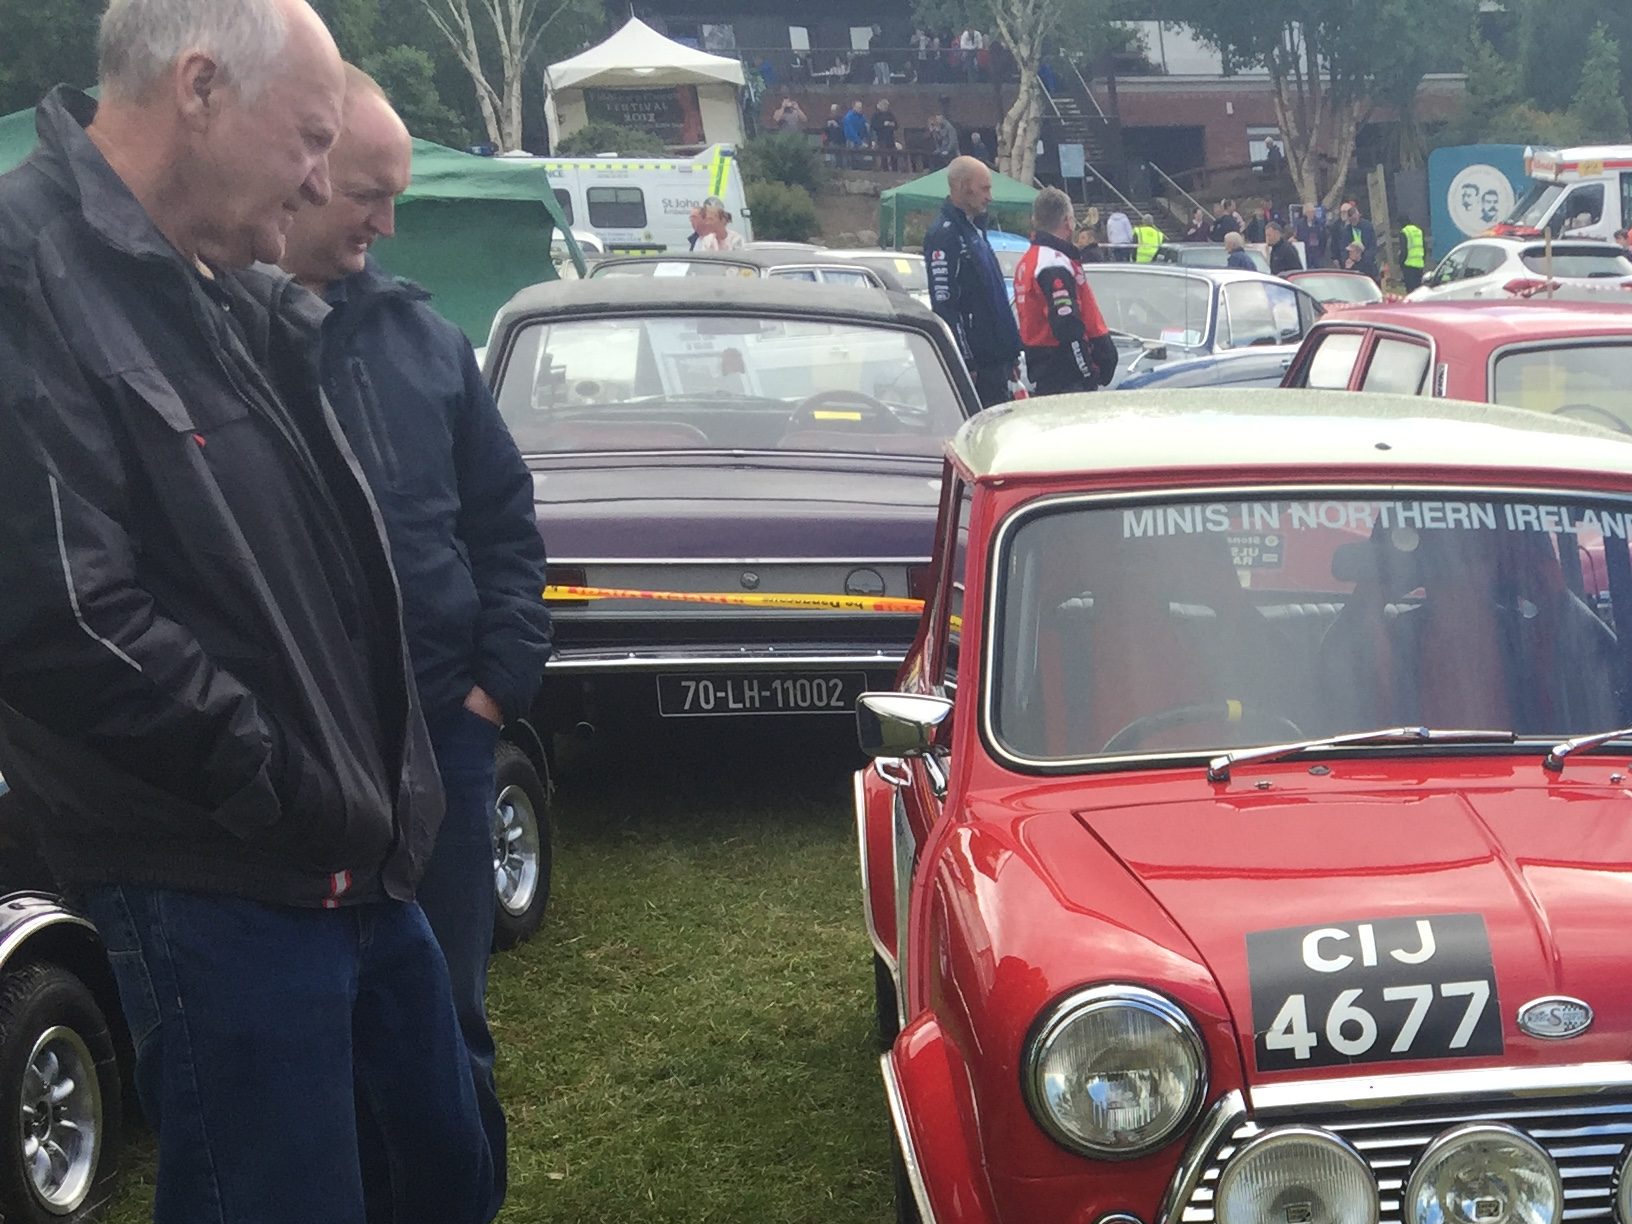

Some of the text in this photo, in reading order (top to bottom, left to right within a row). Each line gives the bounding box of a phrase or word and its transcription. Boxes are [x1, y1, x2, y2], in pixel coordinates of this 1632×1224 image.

[662, 198, 700, 209] St John
[1122, 503, 1230, 538] MINIS
[1241, 502, 1281, 530] IN
[1290, 501, 1497, 530] NORTHERN
[680, 677, 846, 711] 70-LH-11002
[1302, 919, 1437, 973] CIJ
[1264, 980, 1491, 1060] 4677
